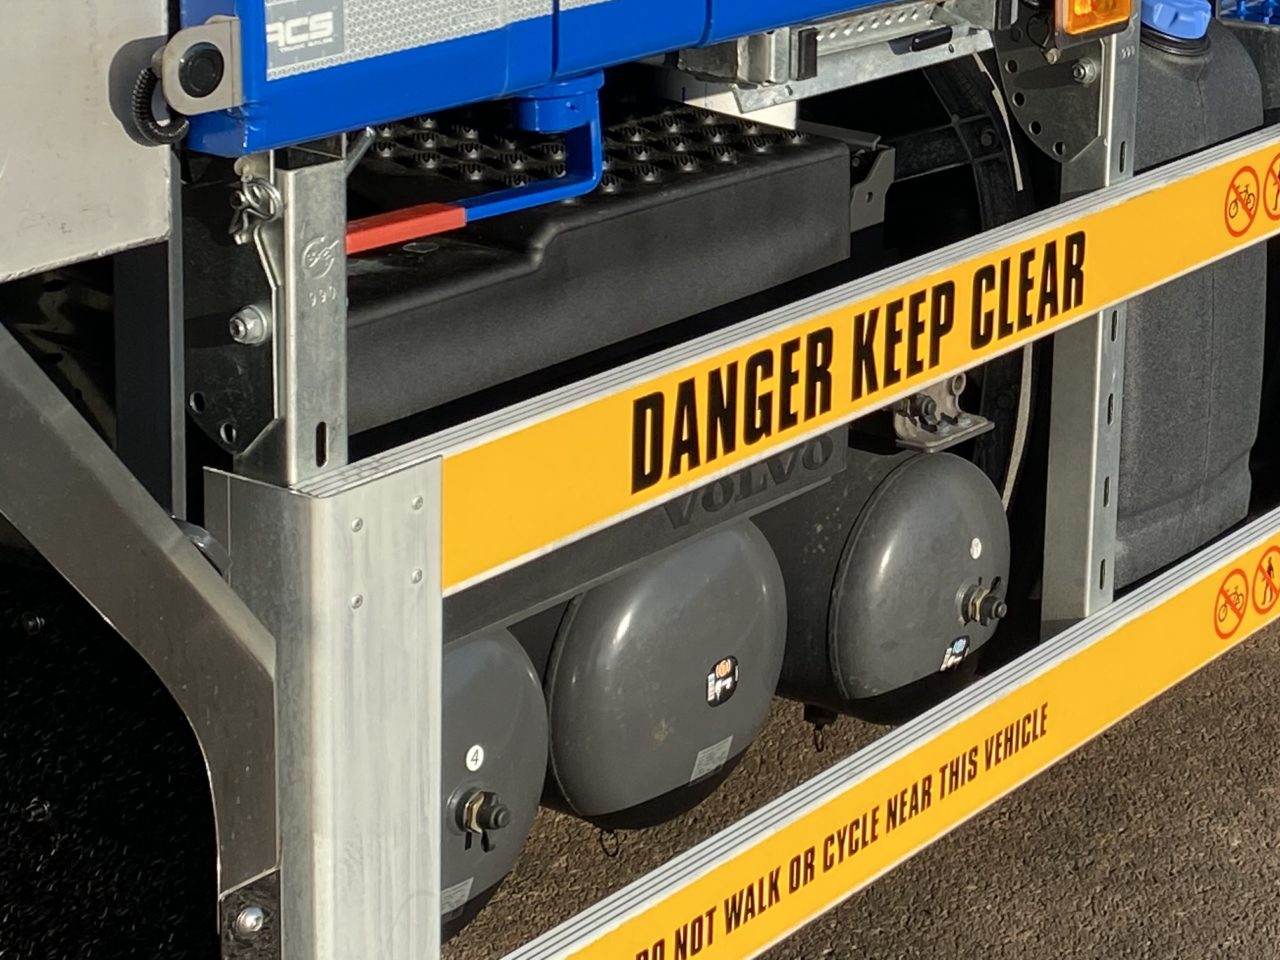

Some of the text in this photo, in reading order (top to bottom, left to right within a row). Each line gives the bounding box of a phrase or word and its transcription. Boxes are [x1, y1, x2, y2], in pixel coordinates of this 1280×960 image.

[631, 230, 1086, 495] DANGER KEEP CLEAR
[662, 433, 834, 530] VOLVO
[674, 906, 717, 960] NOT
[723, 865, 782, 936] WALK
[788, 846, 815, 895] OR
[823, 805, 880, 874] CYCLE
[886, 773, 932, 834] NEAR
[939, 745, 979, 800] THIS
[984, 702, 1048, 772] VEHICLE
